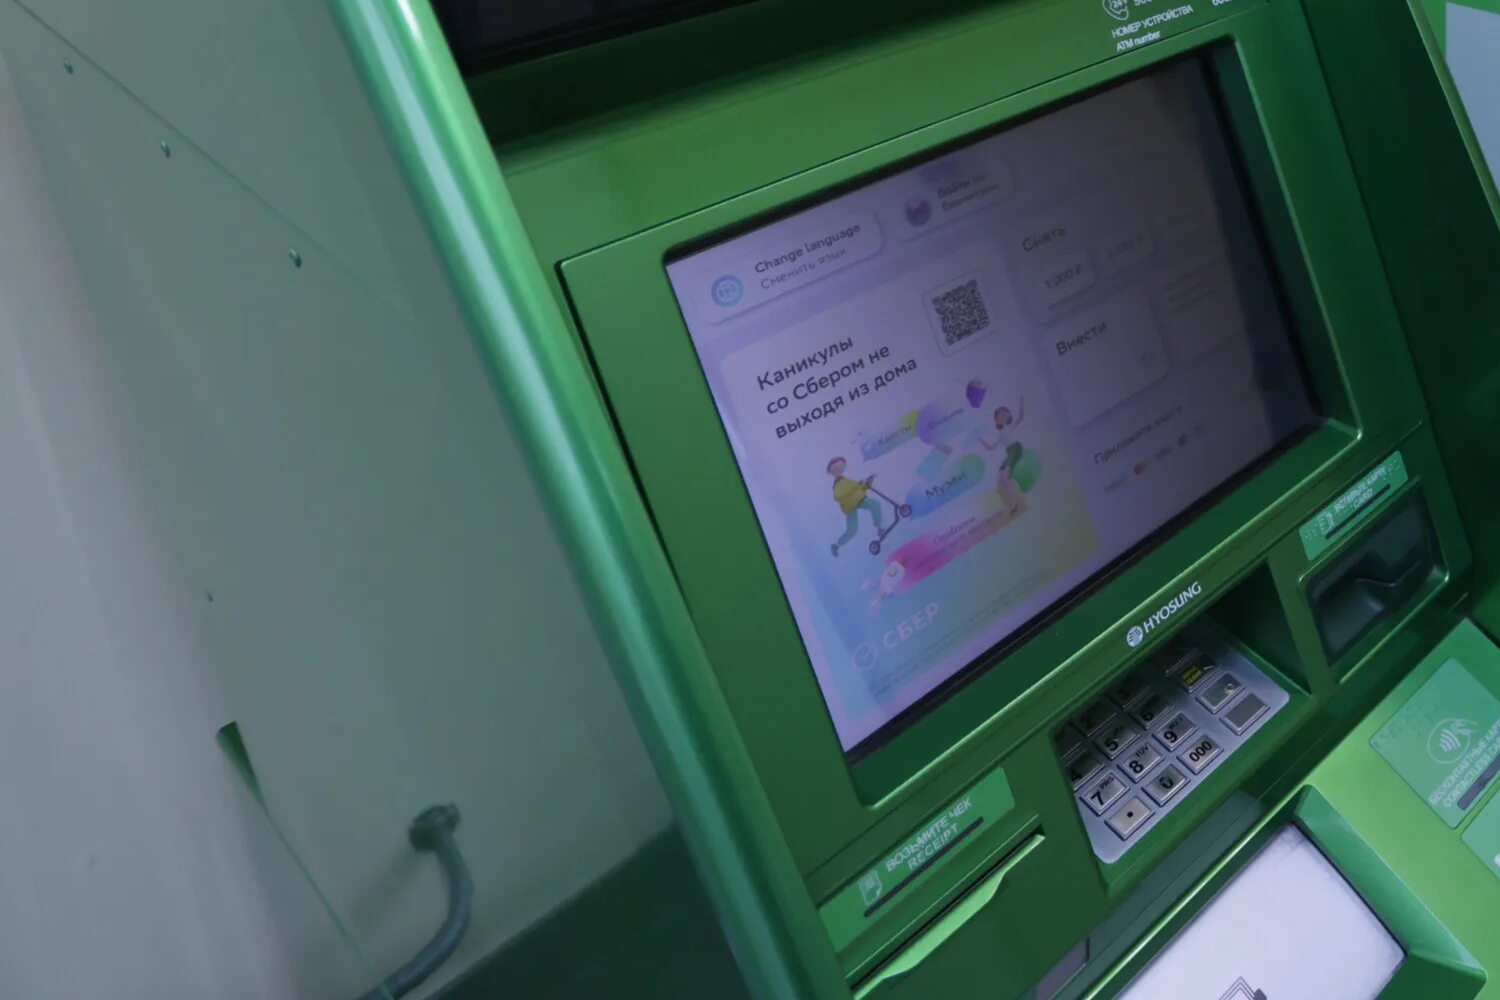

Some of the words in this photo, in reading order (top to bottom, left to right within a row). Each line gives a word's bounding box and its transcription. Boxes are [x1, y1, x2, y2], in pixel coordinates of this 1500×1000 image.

[1112, 22, 1142, 38] НОМЕР
[1142, 5, 1194, 28] УСТРОЙСТВА
[1117, 40, 1134, 52] ATM
[755, 246, 803, 274] Change
[804, 223, 861, 253] Language
[1021, 226, 1067, 253] Снять
[761, 262, 816, 290] Сменить
[1056, 321, 1107, 356] Внести
[756, 336, 854, 390] Каникулы
[767, 394, 790, 415] со
[793, 355, 866, 401] Сбером
[868, 344, 891, 365] не
[774, 392, 846, 440] выходя
[848, 381, 870, 401] из
[873, 356, 918, 390] дома
[1143, 581, 1203, 634] HYOSUNG
[883, 601, 940, 650] СБЕР
[1104, 738, 1119, 752] 5
[1163, 730, 1178, 744] 9
[1189, 740, 1213, 763] 000
[1128, 759, 1144, 774] 8
[1159, 775, 1174, 790] 0
[1443, 750, 1495, 808] CONTACTLESS
[1090, 790, 1105, 806] 7
[885, 815, 951, 872] ВОЗЬМИТЕ
[948, 796, 973, 819] ЧЕК
[907, 822, 958, 870] RECEIPT
